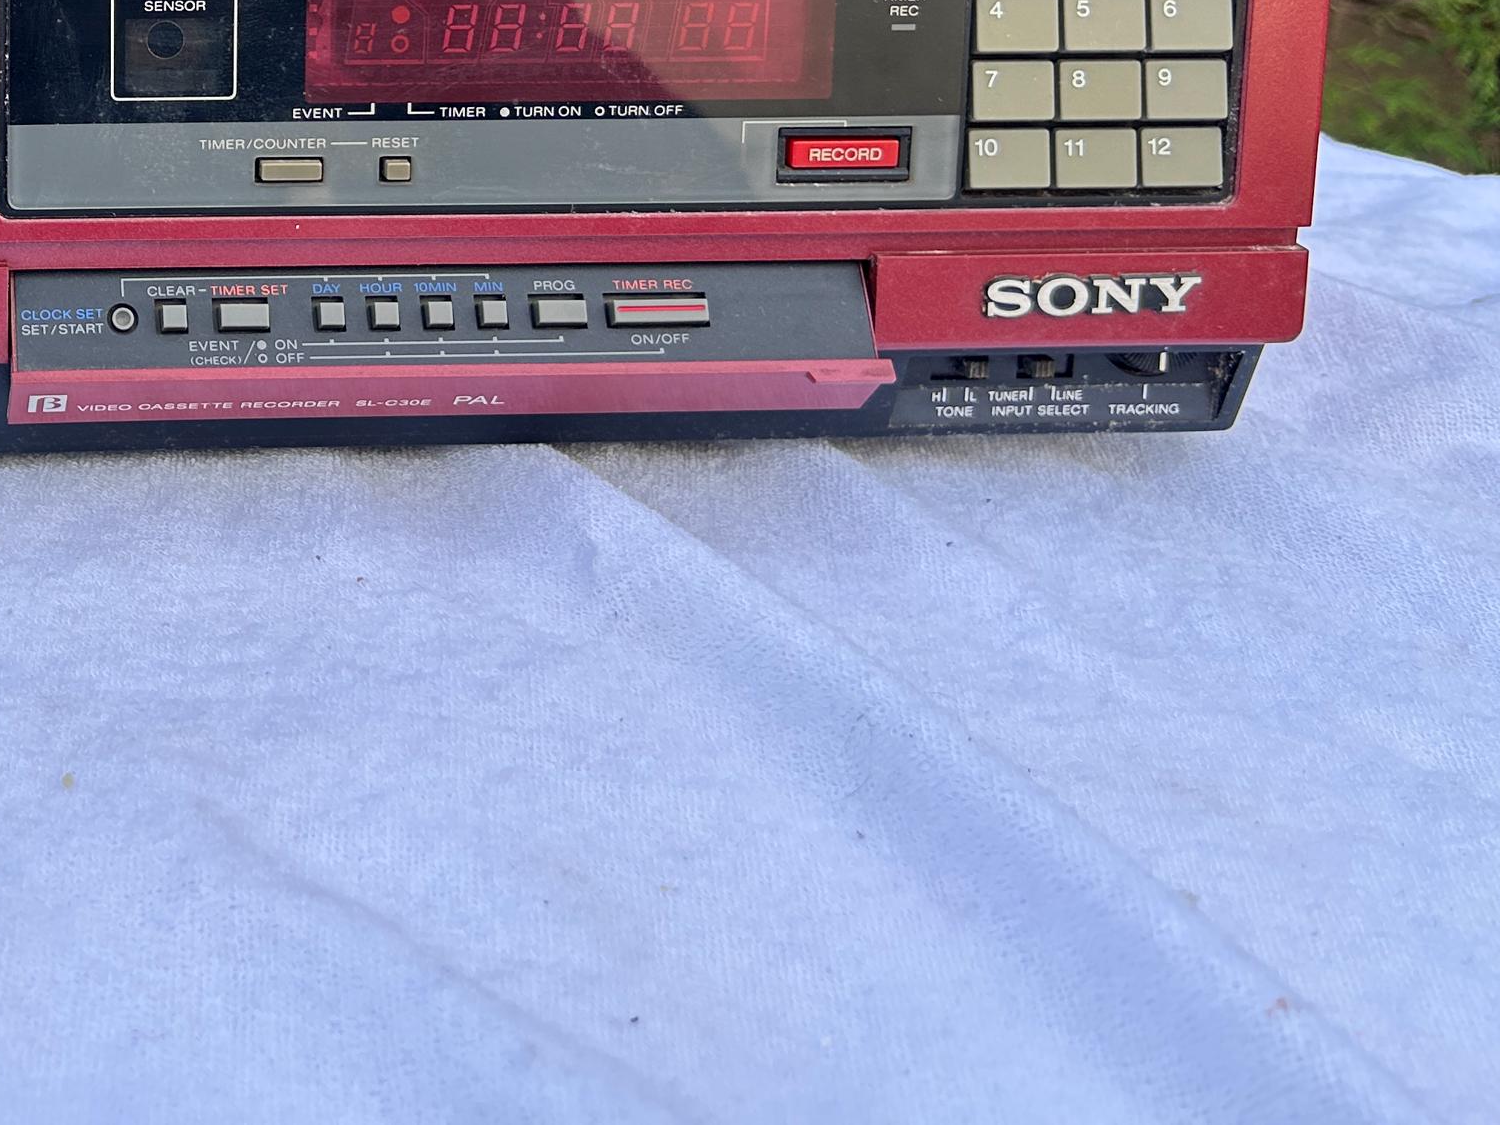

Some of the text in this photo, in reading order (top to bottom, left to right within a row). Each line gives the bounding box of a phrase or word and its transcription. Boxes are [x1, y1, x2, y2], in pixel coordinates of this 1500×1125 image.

[144, 0, 206, 12] SENSOR
[889, 5, 920, 17] REC
[989, 0, 1177, 19] 4 5 6
[985, 69, 1172, 88] 7 8 9
[292, 105, 684, 119] EVENT TIMER TURN ON TURN OFF
[199, 137, 419, 150] TIMER/COUNTER RESET
[974, 138, 1171, 156] 10 11 12
[809, 148, 882, 162] RECORD
[147, 284, 288, 297] CLEAR TIMER SET
[312, 283, 341, 294] DAY
[360, 282, 402, 294] HOUR
[413, 282, 457, 293] 10MIN
[474, 281, 503, 292] MIN
[533, 280, 575, 292] PROG
[612, 279, 693, 291] TIMER REC
[986, 275, 1202, 317] SONY
[21, 308, 103, 321] CLOCK SET
[21, 323, 104, 336] SET/START
[189, 339, 298, 352] EVENT ON
[630, 333, 690, 346] ON/OFF
[190, 353, 305, 366] (CHECK) OFF
[988, 390, 1028, 402] TUNER
[1055, 389, 1083, 401] LINE
[77, 395, 505, 412] VIDEO CASSETTE RECORDER SL-C30E PAL
[936, 403, 1180, 417] TONE INPUT SELECT TRACKING
